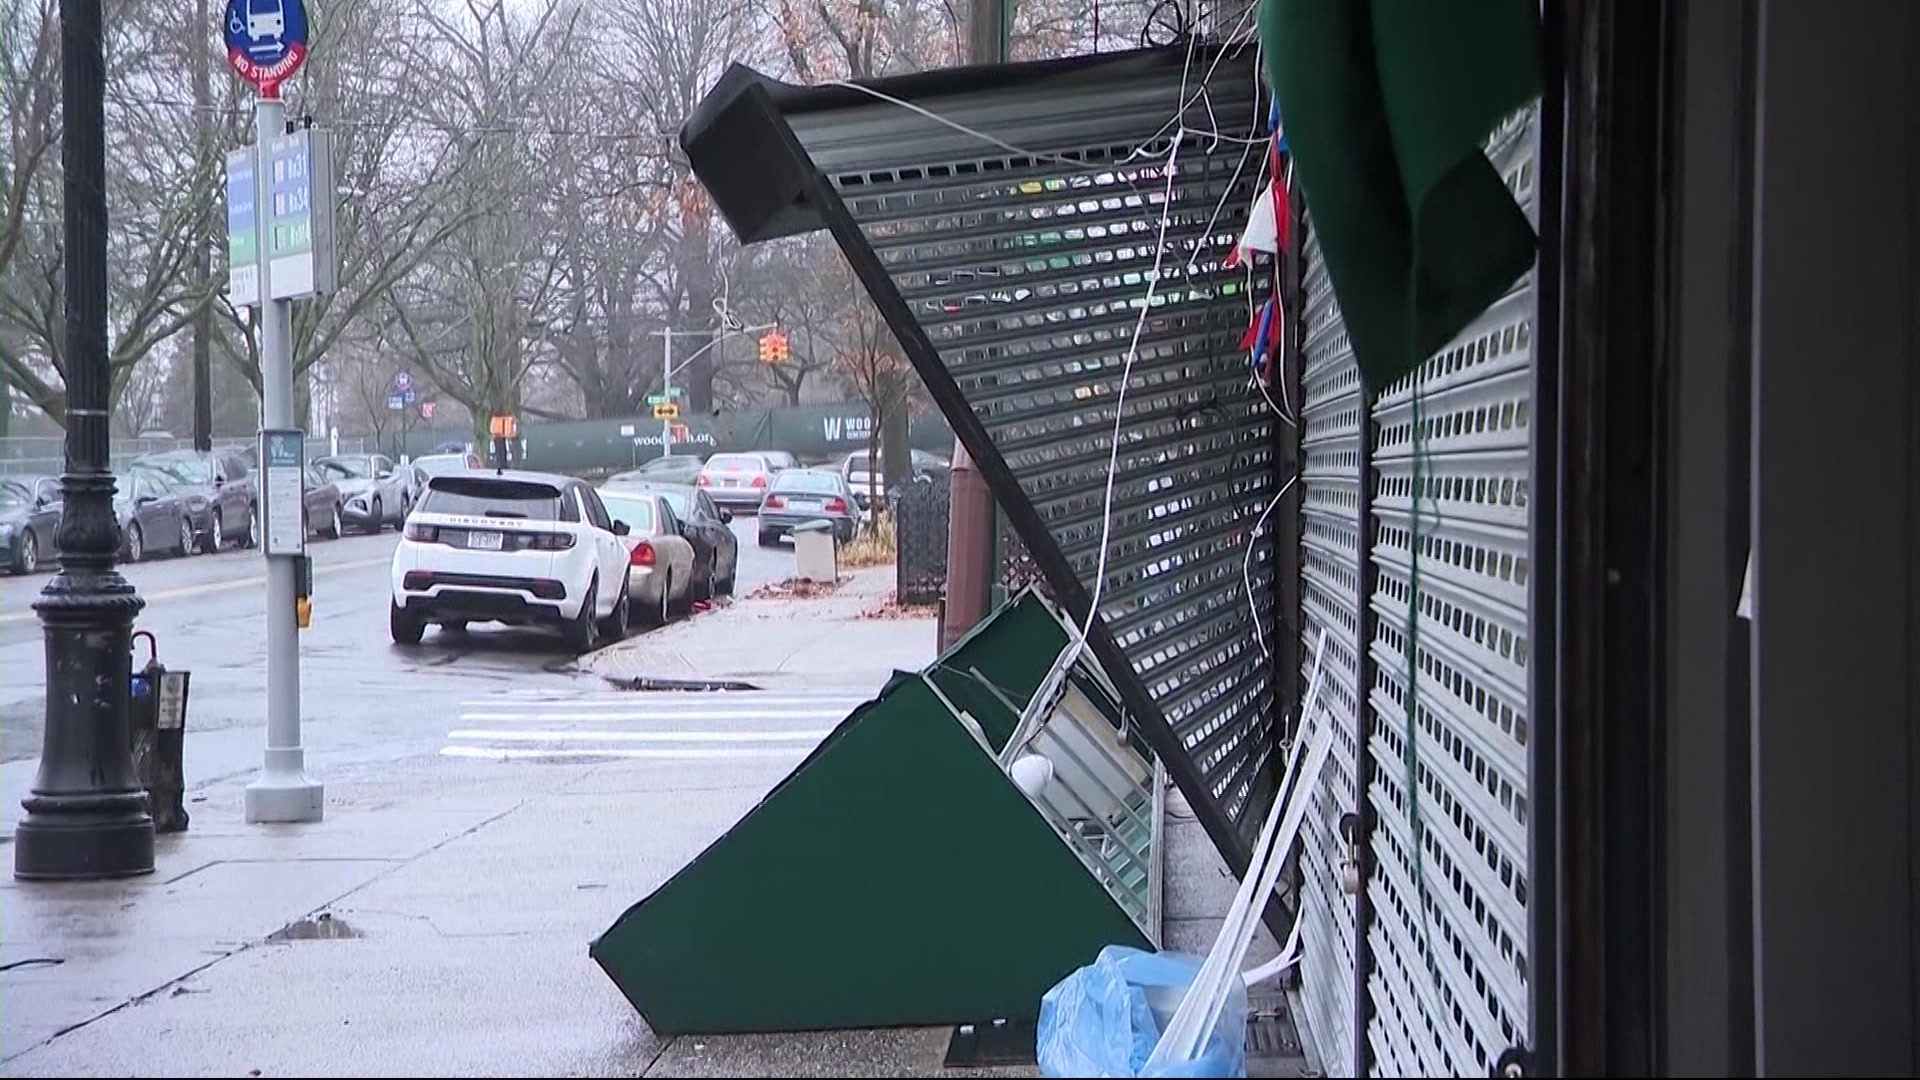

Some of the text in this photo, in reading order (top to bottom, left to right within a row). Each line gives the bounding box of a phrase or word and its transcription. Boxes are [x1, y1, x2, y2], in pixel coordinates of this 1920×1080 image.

[234, 49, 298, 80] NO STANDING
[823, 416, 841, 441] W
[845, 417, 871, 430] WOO
[634, 433, 717, 447] woodan.org
[449, 517, 524, 527] DISCOVERY
